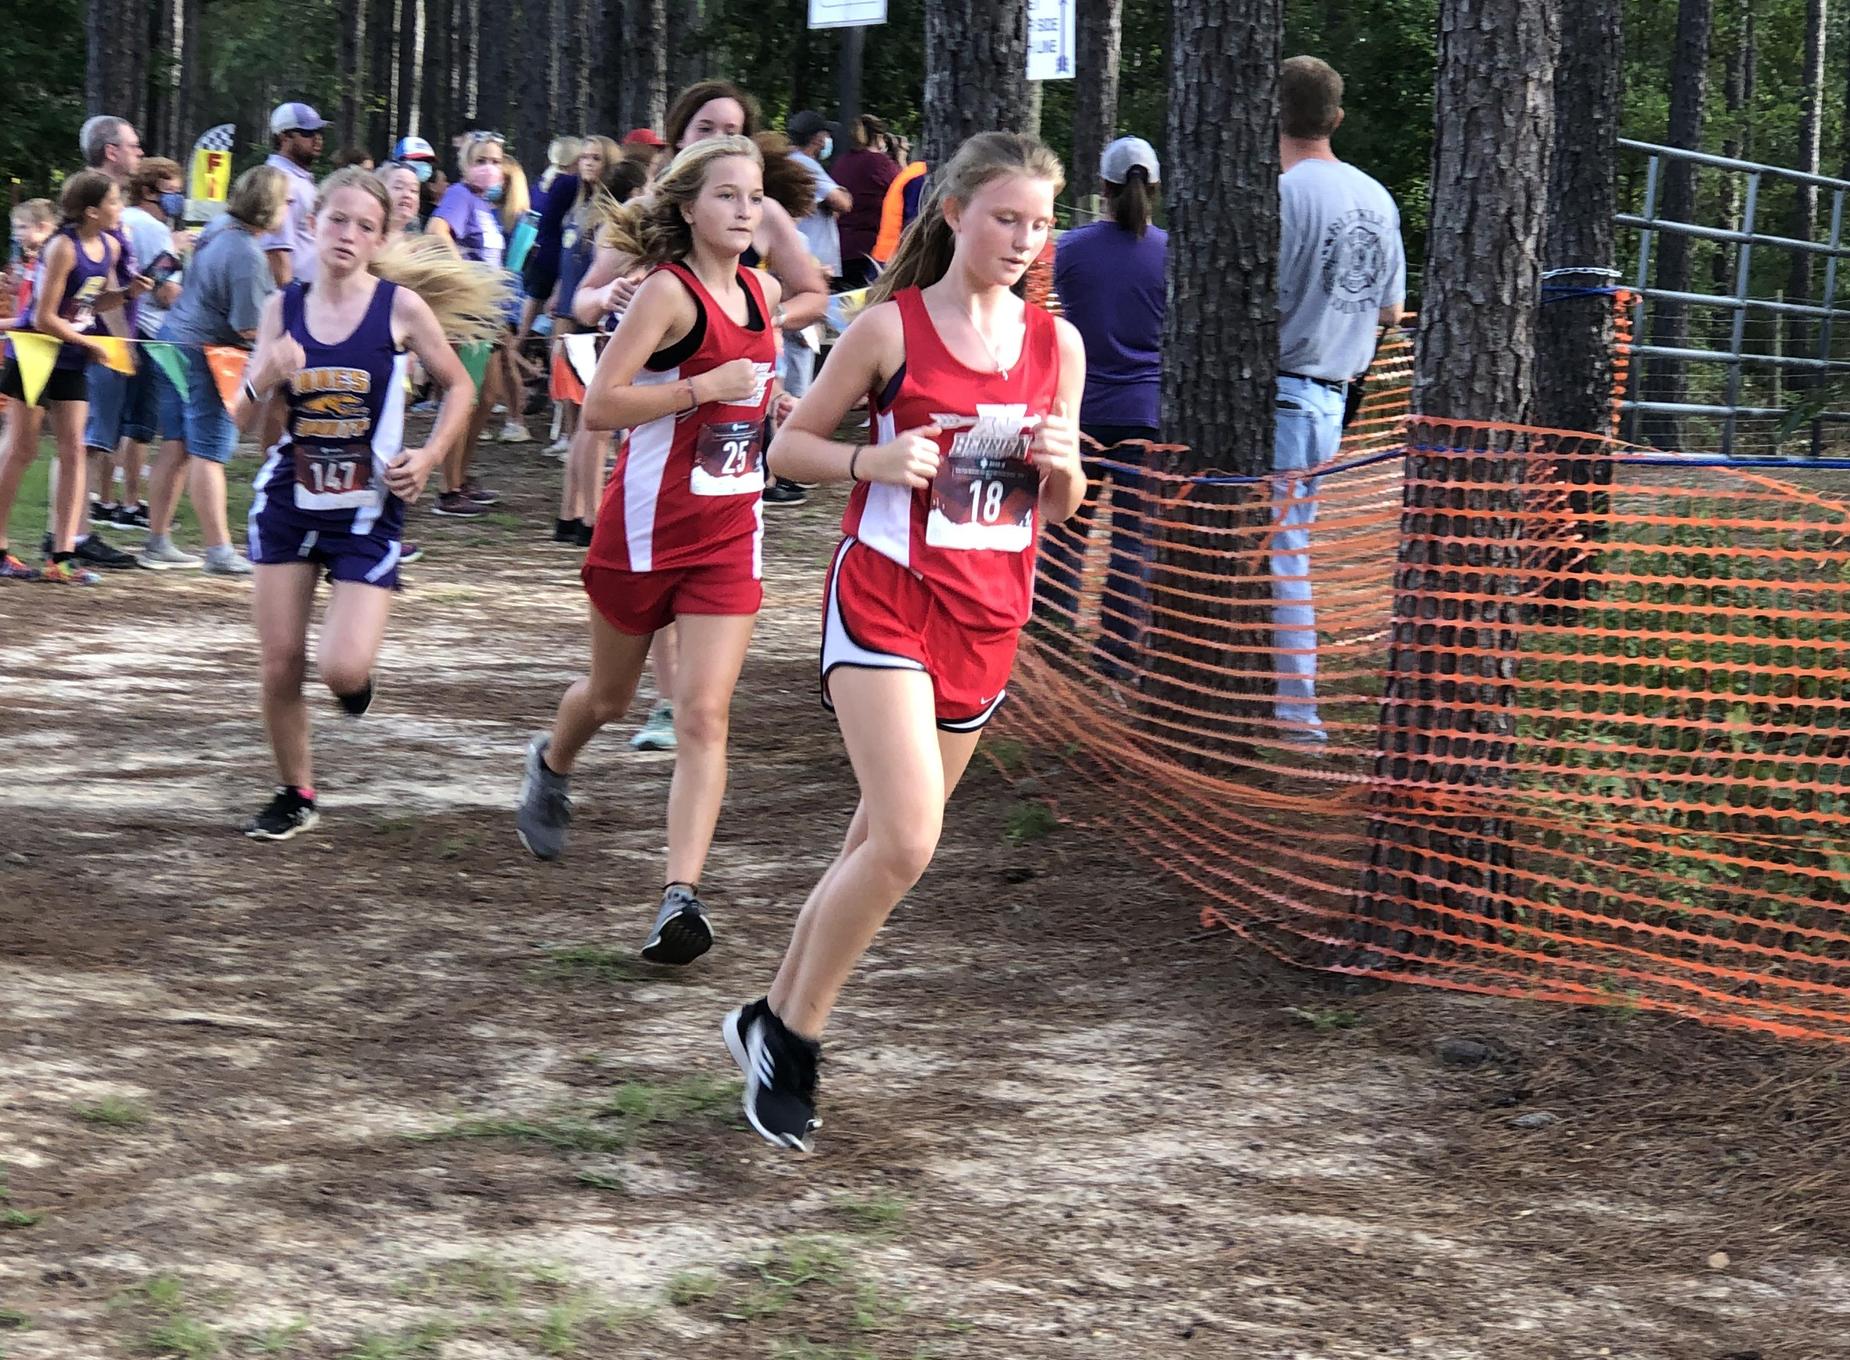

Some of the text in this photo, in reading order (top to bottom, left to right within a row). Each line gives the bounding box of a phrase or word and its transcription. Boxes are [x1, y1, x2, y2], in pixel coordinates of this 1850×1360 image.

[721, 440, 750, 475] 25
[309, 461, 357, 492] 147
[968, 479, 1005, 524] 18
